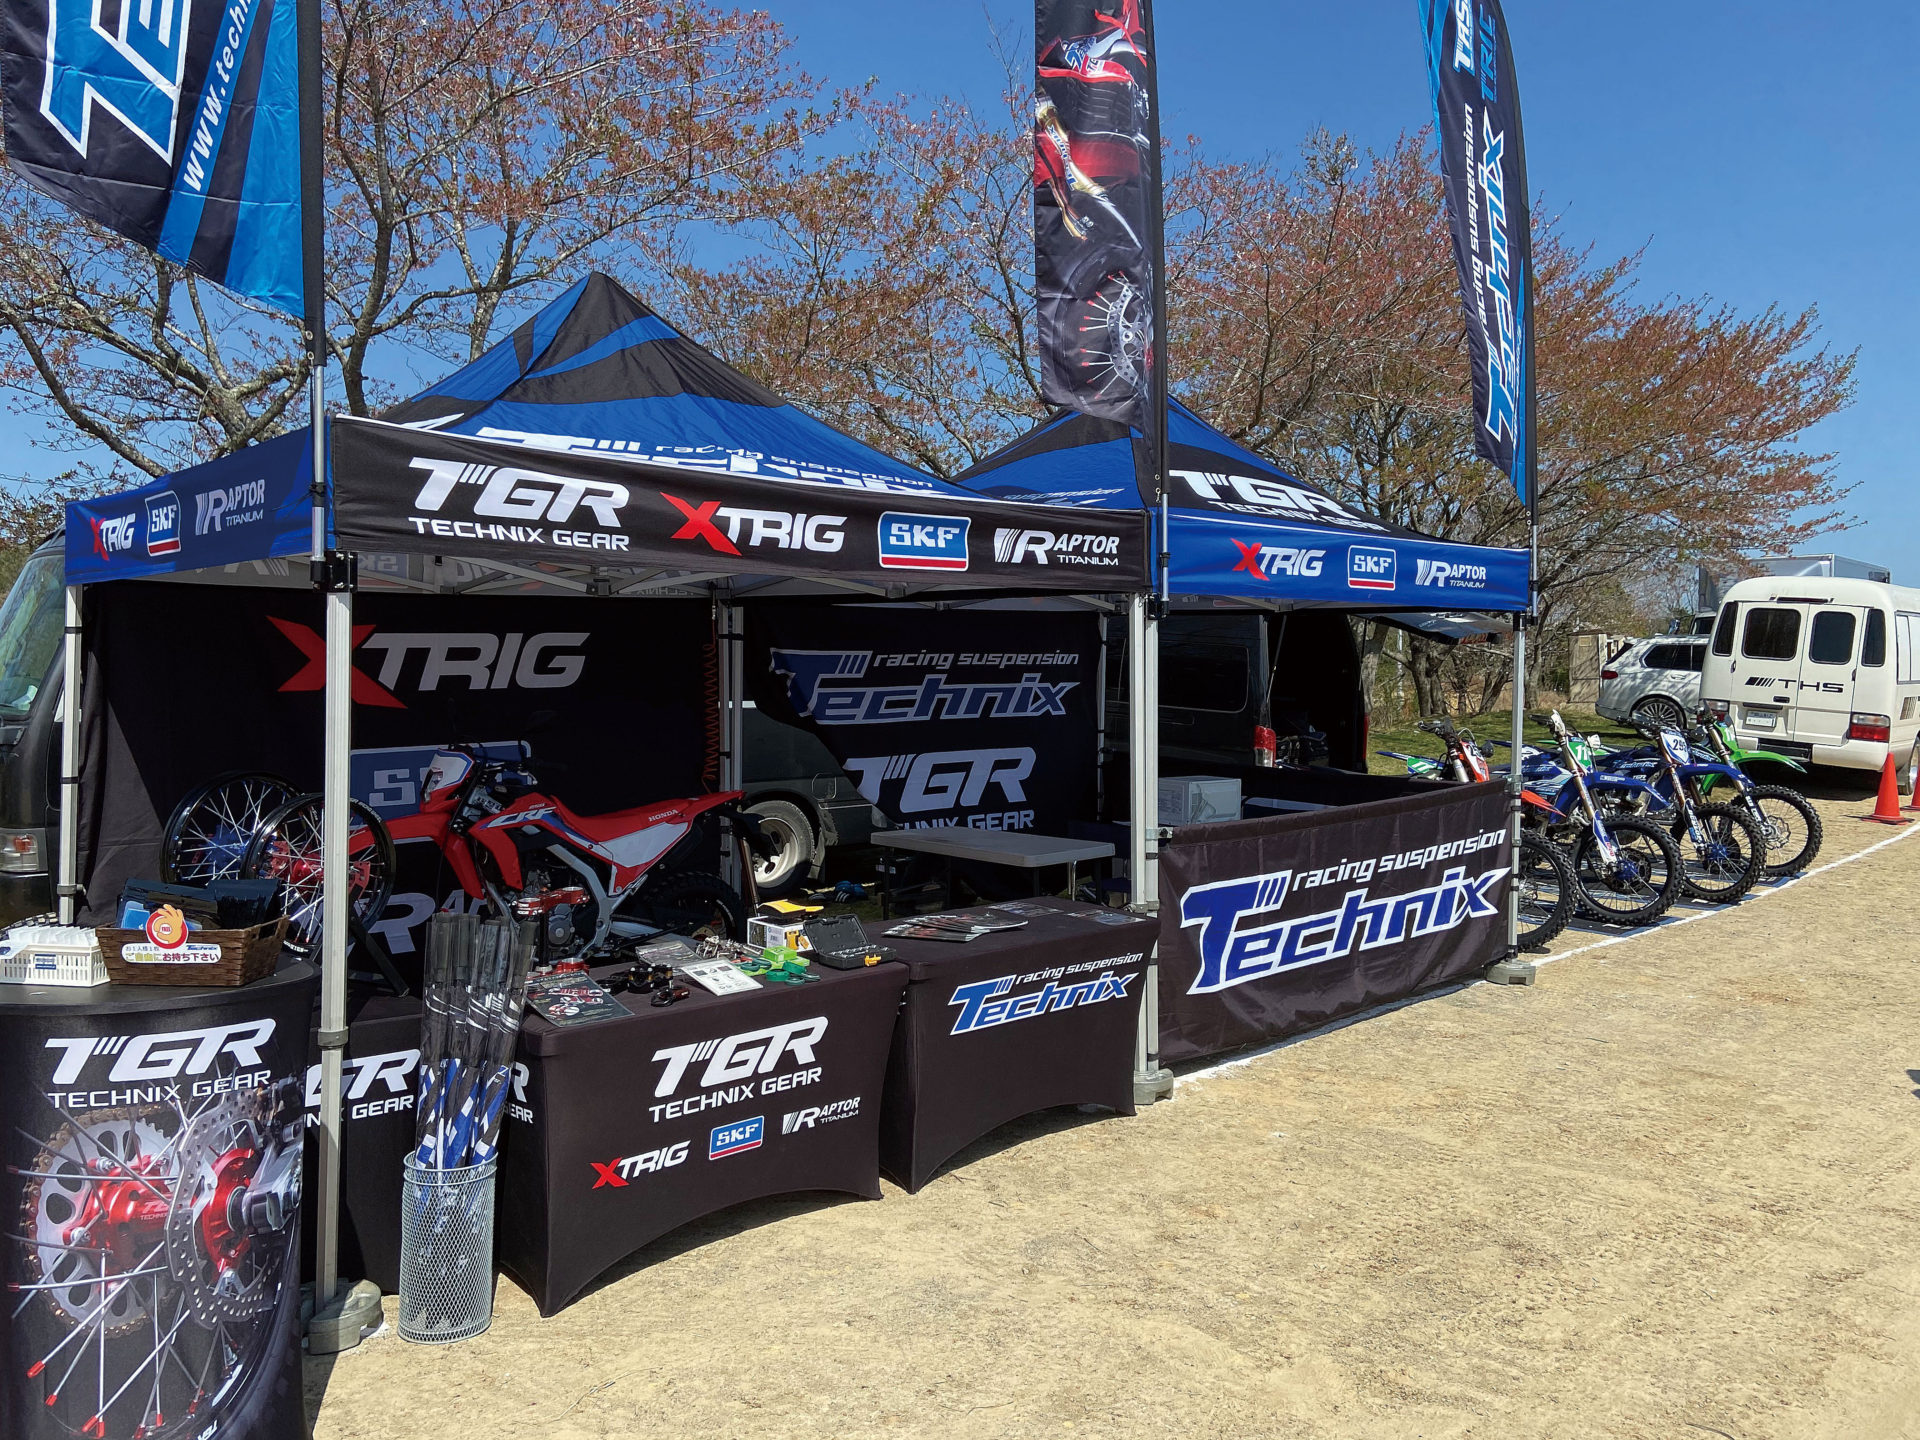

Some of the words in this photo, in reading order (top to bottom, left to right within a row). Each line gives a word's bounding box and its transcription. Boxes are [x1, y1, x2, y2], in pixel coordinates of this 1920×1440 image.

[1463, 102, 1480, 254] suspension
[409, 456, 630, 527] TGR
[1169, 469, 1361, 520] TGR
[151, 504, 178, 532] SKF
[226, 509, 264, 527] TITANIUM
[408, 516, 546, 544] TECHNIX
[552, 529, 630, 551] GEAR
[660, 491, 847, 556] XTRIG
[889, 523, 960, 548] SKF
[90, 513, 136, 561] XTRIG
[1057, 554, 1119, 566] TITANIUM
[1230, 538, 1326, 581] XTRIG
[1353, 555, 1392, 573] SKF
[1449, 580, 1485, 589] TITANIUM
[267, 615, 591, 709] XTRIG
[873, 650, 953, 670] racing
[957, 650, 1079, 669] suspension
[769, 647, 1081, 725] Technix
[1778, 678, 1844, 693] THS
[842, 747, 1037, 813] TGR
[487, 806, 557, 828] CRF
[648, 809, 678, 822] HONDA
[967, 810, 1035, 832] GEAR
[1293, 858, 1377, 891] racing
[1377, 829, 1507, 873] suspension
[1180, 866, 1511, 995] Technix
[1015, 966, 1064, 985] racing
[1065, 953, 1143, 975] suspension
[948, 971, 1139, 1035] Technix
[45, 1018, 276, 1085] TGR
[651, 1016, 829, 1098] TGR
[48, 1084, 181, 1108] TECHNIX
[193, 1070, 271, 1097] GEAR
[649, 1083, 754, 1123] TECHNIX
[761, 1067, 822, 1095] GEAR
[352, 1095, 414, 1120] GEAR
[509, 1103, 534, 1124] EAR
[820, 1110, 859, 1124] TITANIUM
[716, 1122, 760, 1146] SKF
[590, 1140, 691, 1189] XTRIG
